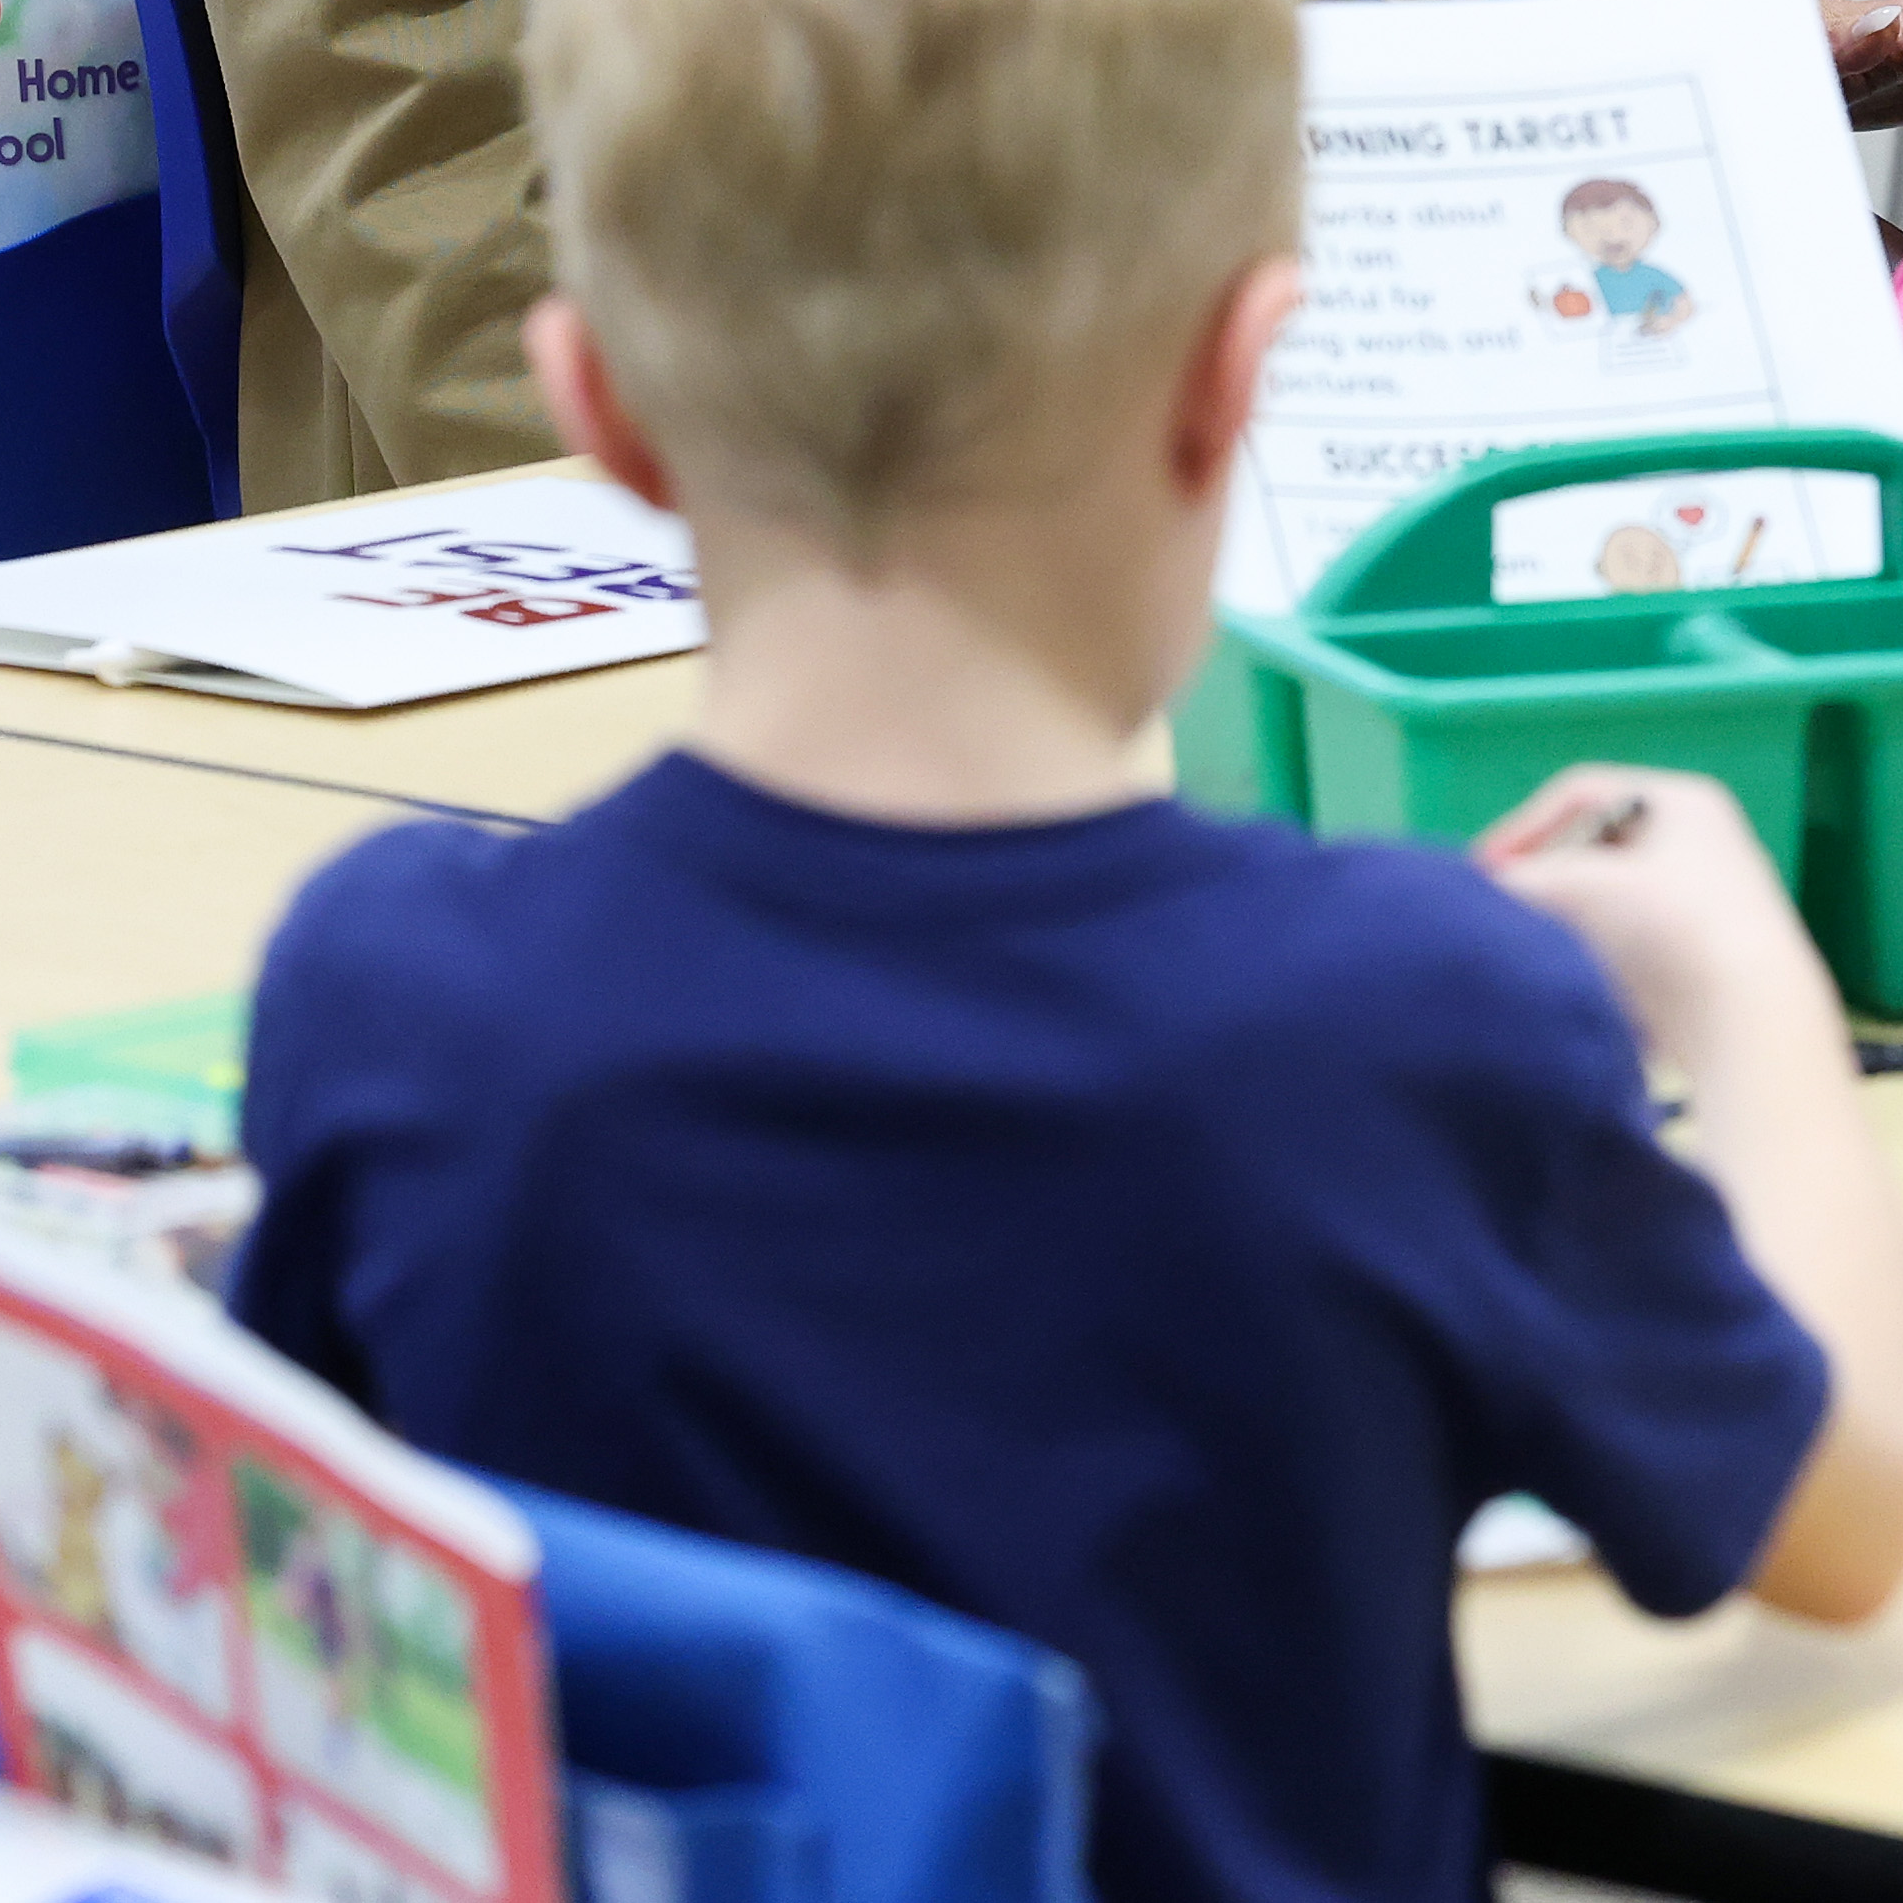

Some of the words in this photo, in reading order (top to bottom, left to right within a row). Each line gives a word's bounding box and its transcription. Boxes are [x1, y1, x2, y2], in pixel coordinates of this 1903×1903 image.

[17, 57, 141, 103] Home
[1305, 123, 1445, 159] RNING
[1464, 107, 1629, 153] TARGET
